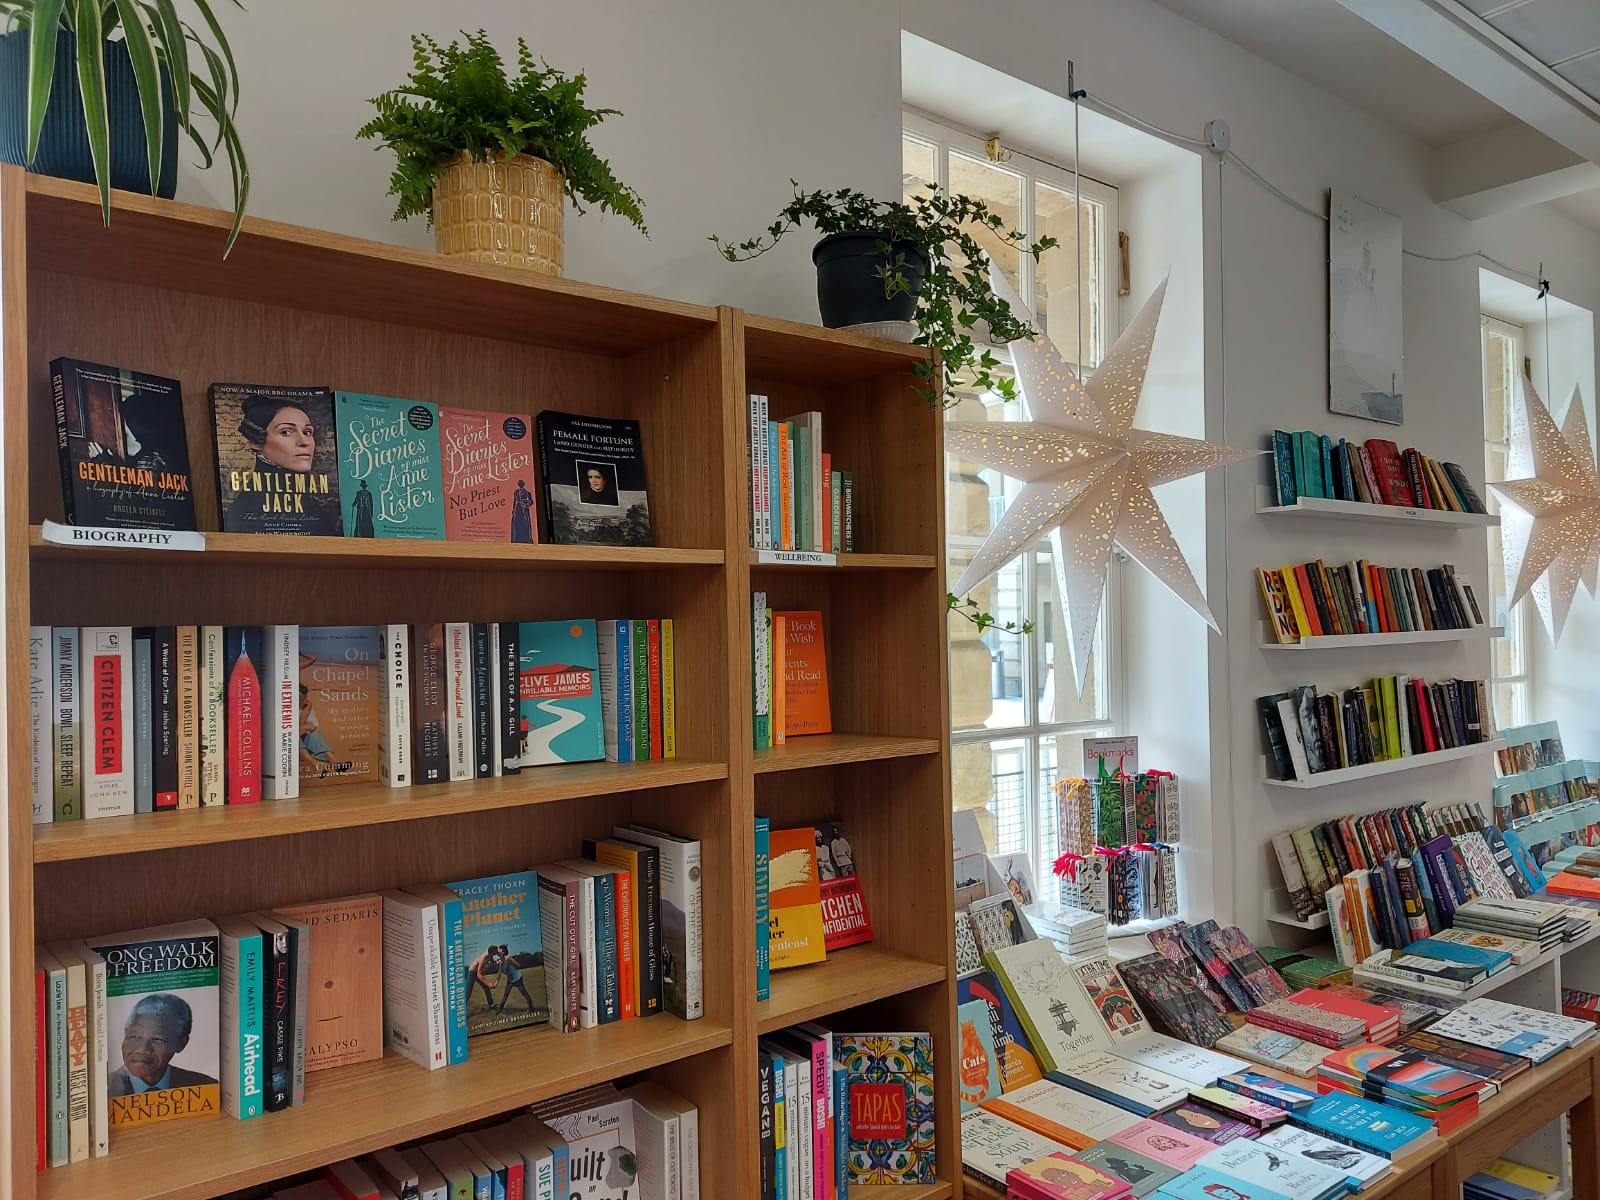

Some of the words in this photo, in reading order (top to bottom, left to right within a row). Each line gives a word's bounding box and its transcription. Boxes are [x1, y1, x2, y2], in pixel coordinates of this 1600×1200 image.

[53, 374, 65, 424] GENTLEMAN
[349, 411, 408, 448] Secret
[365, 415, 384, 428] The
[58, 427, 68, 449] JACK
[445, 419, 491, 450] Secret
[553, 429, 589, 442] FEMALE
[590, 435, 634, 445] FORTUNE
[780, 430, 788, 445] The
[344, 438, 426, 480] Diaries
[412, 456, 429, 466] miss
[441, 440, 507, 476] Diaries
[78, 461, 154, 487] GENTLEMAN
[158, 472, 189, 491] JACK
[230, 471, 329, 494] GENTLEMAN
[379, 465, 430, 493] Anne
[445, 472, 485, 494] Anne
[486, 455, 531, 481] Lister
[93, 481, 124, 499] biography
[450, 495, 467, 509] No
[470, 485, 501, 502] Priest
[113, 504, 137, 514] ANGELA
[262, 492, 304, 513] JACK
[377, 486, 435, 523] Lister
[459, 507, 478, 521] But
[480, 497, 506, 514] Love
[72, 529, 172, 545] BIOGRAPHY
[775, 552, 822, 562] WELLBEING
[791, 621, 817, 631] Book
[791, 633, 814, 643] Wish
[59, 636, 73, 662] JIMMY
[182, 634, 192, 647] THE
[182, 650, 192, 672] DIARY
[207, 634, 216, 680] Confessions
[344, 647, 369, 661] On
[60, 663, 73, 703] ANDERSON
[182, 675, 192, 684] OF
[208, 681, 216, 689] of
[281, 680, 293, 690] IN
[312, 666, 369, 685] Chapel
[519, 675, 549, 688] CLIVE
[553, 673, 591, 686] JAMES
[797, 670, 822, 681] Read
[101, 660, 114, 721] CITIZEN
[319, 686, 369, 703] Sands
[508, 684, 515, 696] OF
[558, 684, 591, 692] MEMOIRS
[242, 677, 252, 725] MICHAEL
[281, 691, 293, 729] EXTREMIS
[456, 702, 464, 719] Land
[640, 693, 648, 728] WINDING
[60, 708, 73, 732] BOWL.
[183, 695, 192, 738] BOOKSELLER
[208, 699, 217, 754] BOOKSELLER
[508, 717, 516, 736] GILL
[60, 734, 73, 758] SLEEP.
[102, 727, 115, 769] CLEM
[242, 729, 252, 776] COLLINS
[60, 760, 73, 790] REPEAT.
[493, 879, 526, 891] THORN
[621, 878, 629, 890] THE
[756, 853, 769, 925] SIMPLY
[647, 886, 655, 921] Freeman
[821, 893, 863, 920] TCHEN
[325, 909, 379, 924] SEDARIS
[453, 919, 462, 936] THE
[463, 906, 520, 928] Planet
[823, 914, 867, 935] NFIDENTIAL
[106, 946, 153, 965] ONG
[158, 941, 215, 958] WALK
[426, 918, 437, 971] Unspeakable
[447, 945, 456, 966] ANNA
[604, 937, 613, 970] Hitler's
[622, 941, 630, 962] WATER
[114, 954, 215, 977] FREEDOM
[247, 951, 256, 981] EMILY
[453, 939, 464, 984] AMERICAN
[648, 958, 656, 981] Glass
[1076, 961, 1096, 977] EXTRA
[1094, 959, 1111, 971] TIME
[275, 961, 287, 1017] PREY
[430, 971, 439, 1002] Harriet
[448, 967, 458, 1010] PASTERNAK
[604, 971, 614, 997] Table
[247, 986, 256, 1028] MAITLIS
[455, 987, 466, 1028] DUCHESS
[69, 1004, 87, 1067] HEAVY
[276, 1020, 284, 1047] CASSIE
[432, 1003, 441, 1046] Shawcross
[1058, 1033, 1096, 1053] Together
[243, 1033, 261, 1097] Airhead
[276, 1048, 284, 1064] PIKE
[962, 1055, 986, 1070] Cats
[1169, 1052, 1197, 1065] GOOD
[70, 1067, 87, 1091] KIESE
[775, 1070, 783, 1099] BOSH!
[815, 1051, 825, 1095] SPEEDY
[71, 1093, 87, 1122] LAYMON
[111, 1087, 203, 1112] NELSON
[760, 1067, 770, 1131] VEGAN
[788, 1095, 797, 1109] 15
[855, 1093, 901, 1122] TAPAS
[587, 1112, 600, 1124] Paul
[599, 1116, 620, 1128] Scraton
[789, 1109, 797, 1137] minute
[816, 1097, 826, 1130] BOSH!
[986, 1137, 1035, 1160] Soup!
[538, 1164, 551, 1189] SUE
[570, 1148, 606, 1182] uilt
[588, 1184, 597, 1193] on
[802, 1176, 811, 1199] budget
